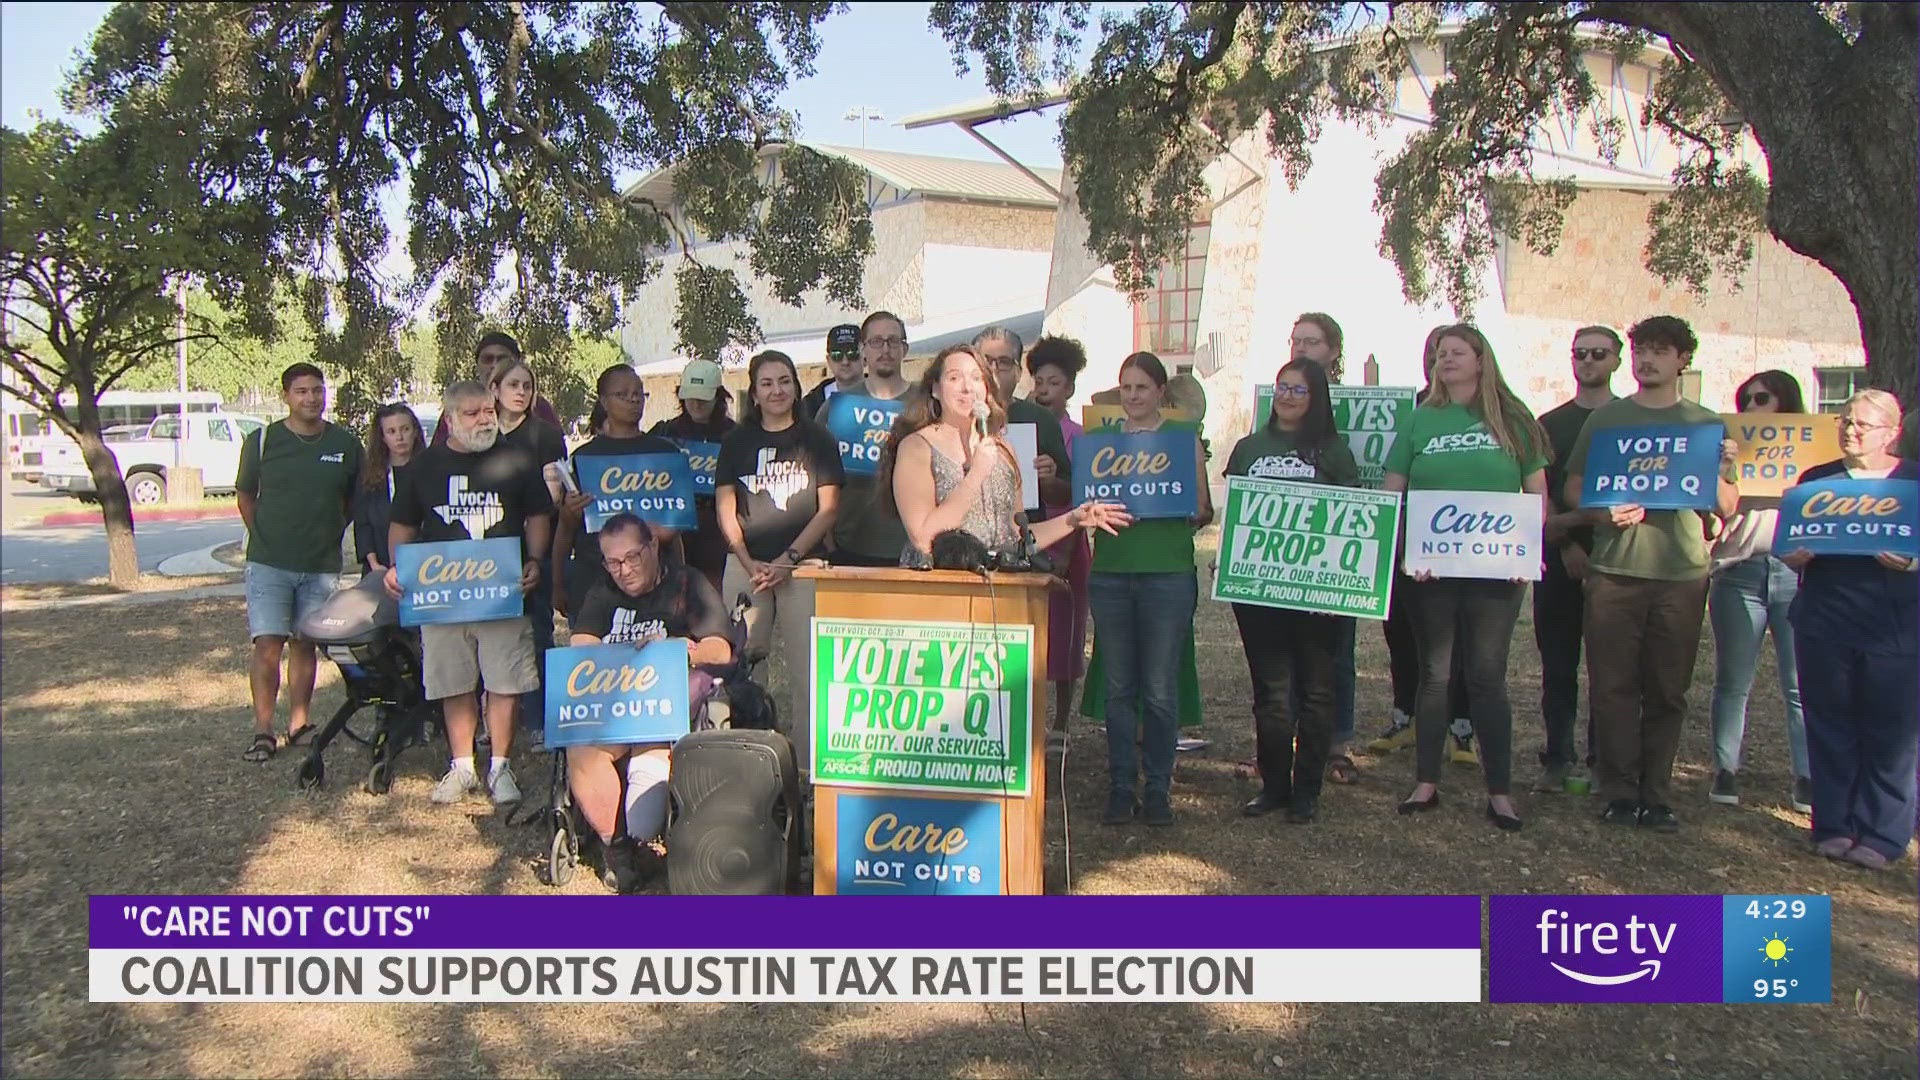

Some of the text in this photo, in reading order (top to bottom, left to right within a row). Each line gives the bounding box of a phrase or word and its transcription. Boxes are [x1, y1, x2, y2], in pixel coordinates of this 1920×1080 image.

[853, 407, 900, 426] VOT
[1347, 398, 1397, 430] YES
[1425, 432, 1498, 449] AFSCM
[1617, 437, 1688, 454] VOTE
[1741, 426, 1813, 442] VOTE
[838, 441, 881, 462] PRO
[1363, 433, 1384, 465] Q
[1755, 446, 1795, 461] FOR
[1091, 446, 1171, 478] Care
[1627, 456, 1669, 473] FOR
[1741, 463, 1797, 479] ROP
[600, 467, 673, 494] Care
[1084, 481, 1182, 498] NOT CUTS
[1596, 475, 1700, 496] PROP Q
[458, 491, 502, 506] VOCAL
[597, 498, 685, 512] NOT CUTS
[1800, 490, 1901, 519] Care
[450, 507, 483, 515] TEXAS
[1240, 492, 1379, 538] VOTE YES
[1430, 504, 1516, 534] Care
[1789, 522, 1912, 537] NOT CUTS
[1242, 530, 1362, 573] PROP. Q
[1422, 541, 1527, 556] NOT CUTS
[418, 554, 498, 585] Care
[1231, 562, 1372, 590] OUR CITY. OUR SERVICES.
[412, 585, 510, 605] NOT CUTS
[1263, 584, 1302, 601] PROUD
[1304, 589, 1343, 606] UNION
[1344, 593, 1380, 610] HOME
[920, 630, 951, 639] ELECTION
[833, 637, 1007, 689] VOTE YES
[567, 660, 660, 698] Care
[559, 699, 673, 721] NOT CUTS
[843, 687, 990, 738] PROP. Q
[831, 732, 1005, 758] OUR CITY. OUR SERVICES.
[873, 758, 923, 778] PROUD
[925, 761, 972, 782] UNION
[974, 764, 1018, 784] HOME
[865, 812, 969, 855] Care
[855, 859, 981, 884] NOT CUTS
